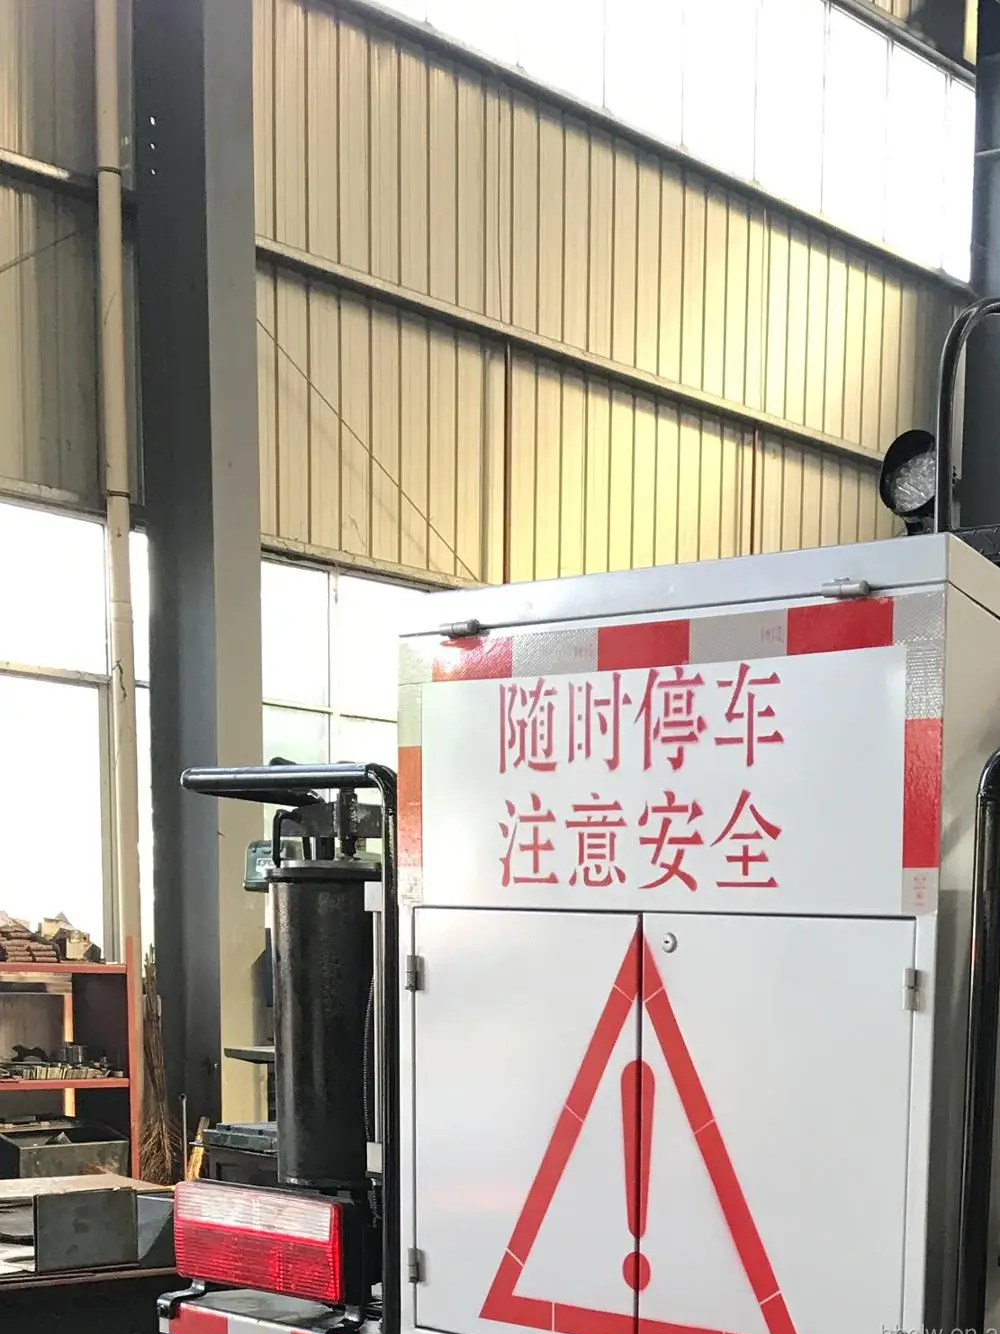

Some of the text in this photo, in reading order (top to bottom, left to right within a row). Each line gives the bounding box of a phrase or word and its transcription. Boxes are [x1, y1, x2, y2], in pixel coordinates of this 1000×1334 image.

[498, 662, 785, 774] 随时停车
[497, 789, 783, 892] 注意安全
